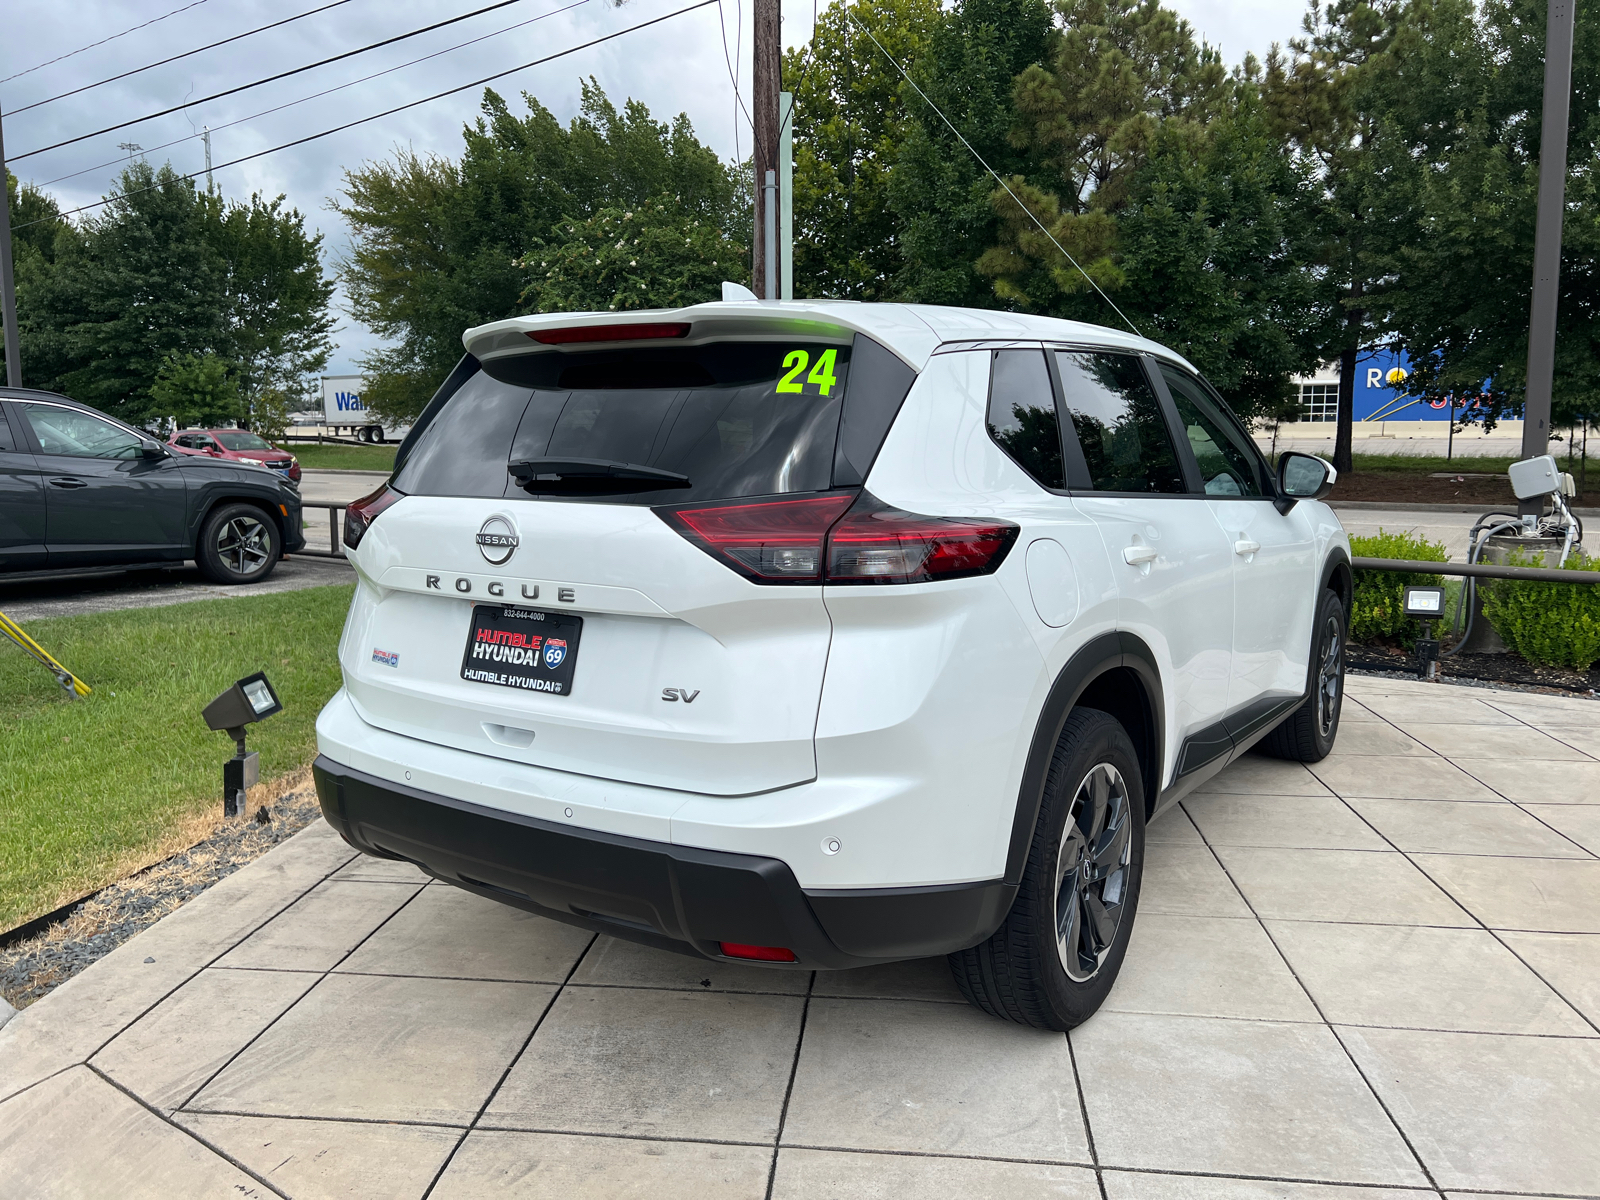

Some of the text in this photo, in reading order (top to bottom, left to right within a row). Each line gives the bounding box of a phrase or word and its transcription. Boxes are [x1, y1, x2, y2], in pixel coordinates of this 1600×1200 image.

[775, 348, 837, 396] 24
[335, 391, 368, 411] Wal
[476, 535, 517, 546] NISSAN
[426, 574, 576, 603] ROGUE
[503, 608, 545, 621] 832-644-4000
[476, 628, 542, 649] HUMBLE
[472, 641, 540, 667] HYUNDAI
[546, 649, 562, 664] 69
[464, 668, 507, 684] HUMBLE
[508, 674, 555, 692] HYUNDAI
[661, 687, 701, 703] SV
